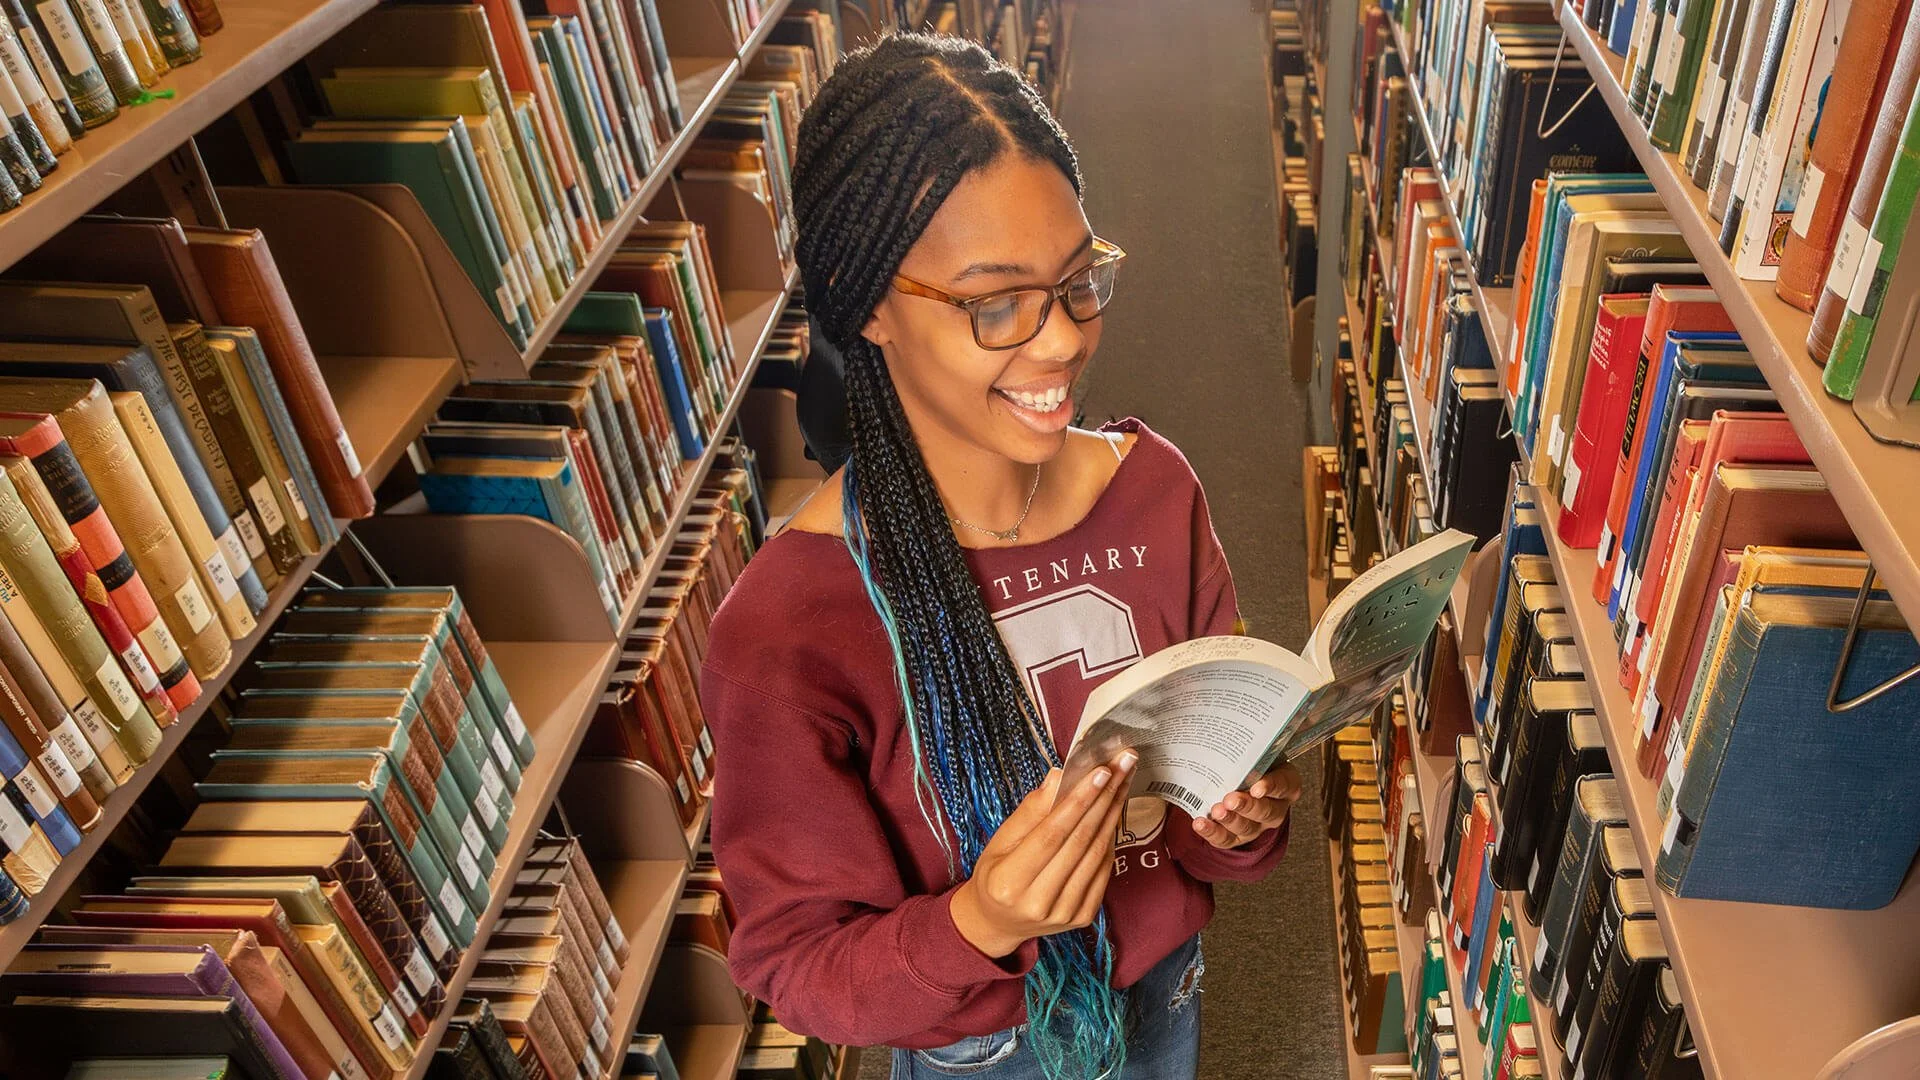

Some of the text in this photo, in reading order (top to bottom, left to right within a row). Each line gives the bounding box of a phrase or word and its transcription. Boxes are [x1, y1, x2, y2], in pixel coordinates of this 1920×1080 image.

[168, 363, 193, 400] FIRST
[977, 545, 1148, 600] TENARY
[1114, 848, 1171, 877] EG
